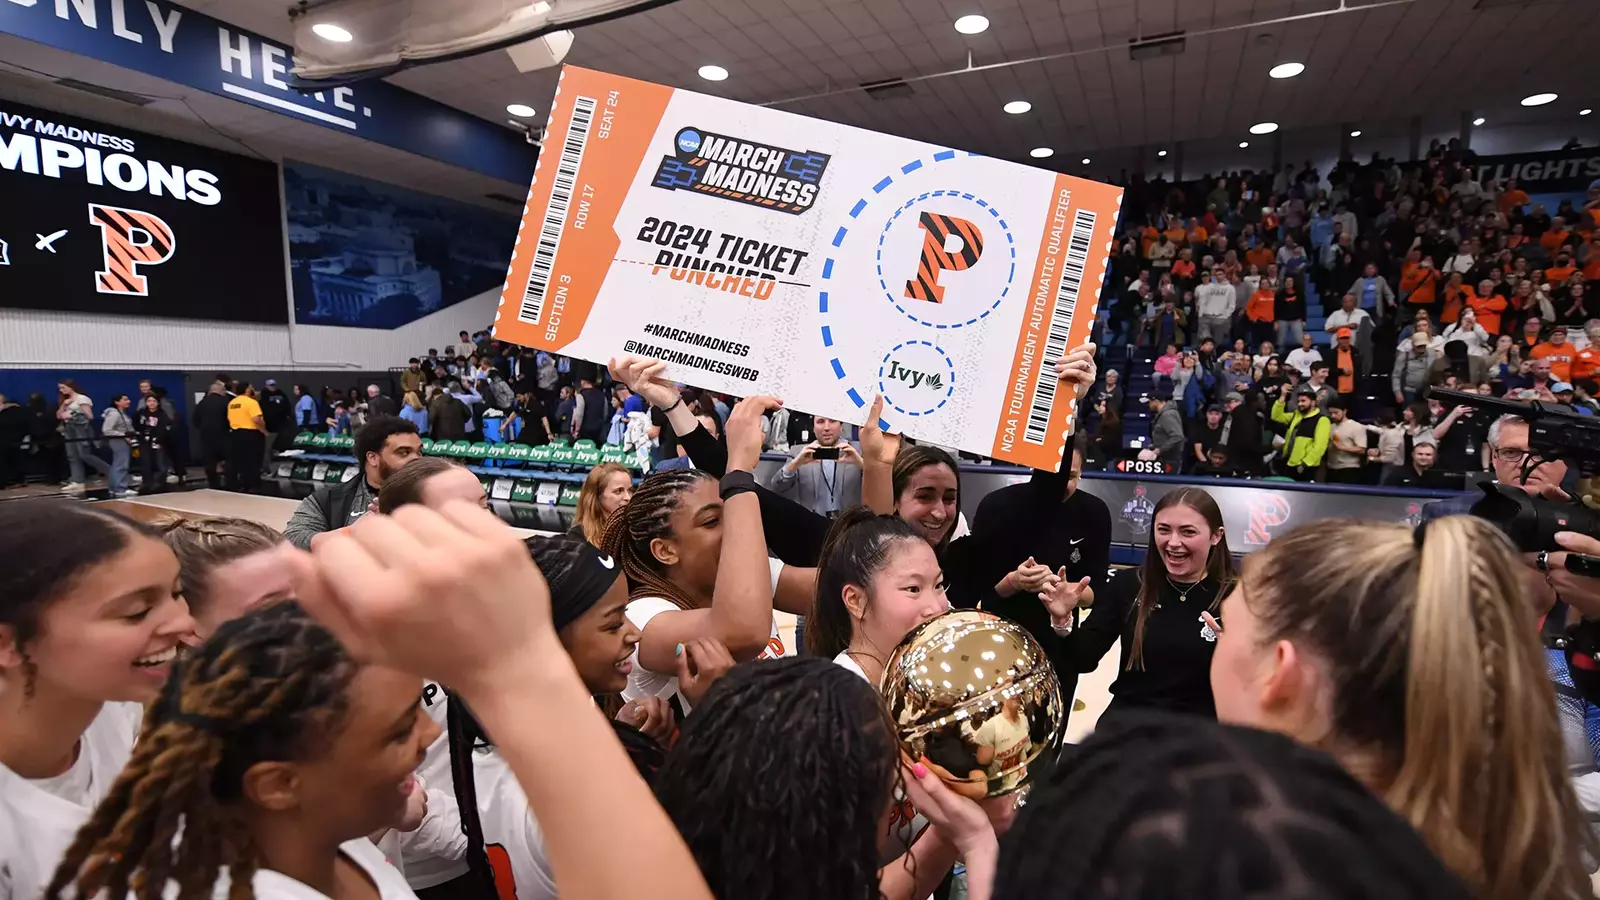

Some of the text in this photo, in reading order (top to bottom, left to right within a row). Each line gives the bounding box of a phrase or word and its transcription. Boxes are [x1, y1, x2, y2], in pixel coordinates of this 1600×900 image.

[8, 0, 372, 117] NLY HEE.
[35, 119, 135, 153] MADNESS
[598, 90, 620, 140] SEAT 24
[679, 138, 699, 149] NCAA
[697, 135, 786, 174] MARCH
[574, 184, 596, 230] ROW 17
[701, 162, 817, 207] MADNESS
[88, 203, 176, 297] P
[636, 216, 809, 276] 2024 TICKET
[904, 211, 984, 304] P
[651, 249, 777, 301] PUNCHED
[545, 274, 572, 342] SECTION 3
[1001, 188, 1072, 452] NCAA TOURNAMENT AUTOMATIC QUALIFIER
[623, 340, 760, 382] @MARCHMADNESSWBB
[643, 323, 751, 357] #MARCHMADNESS
[888, 360, 926, 389] Ivy
[1125, 460, 1164, 473] POSS.
